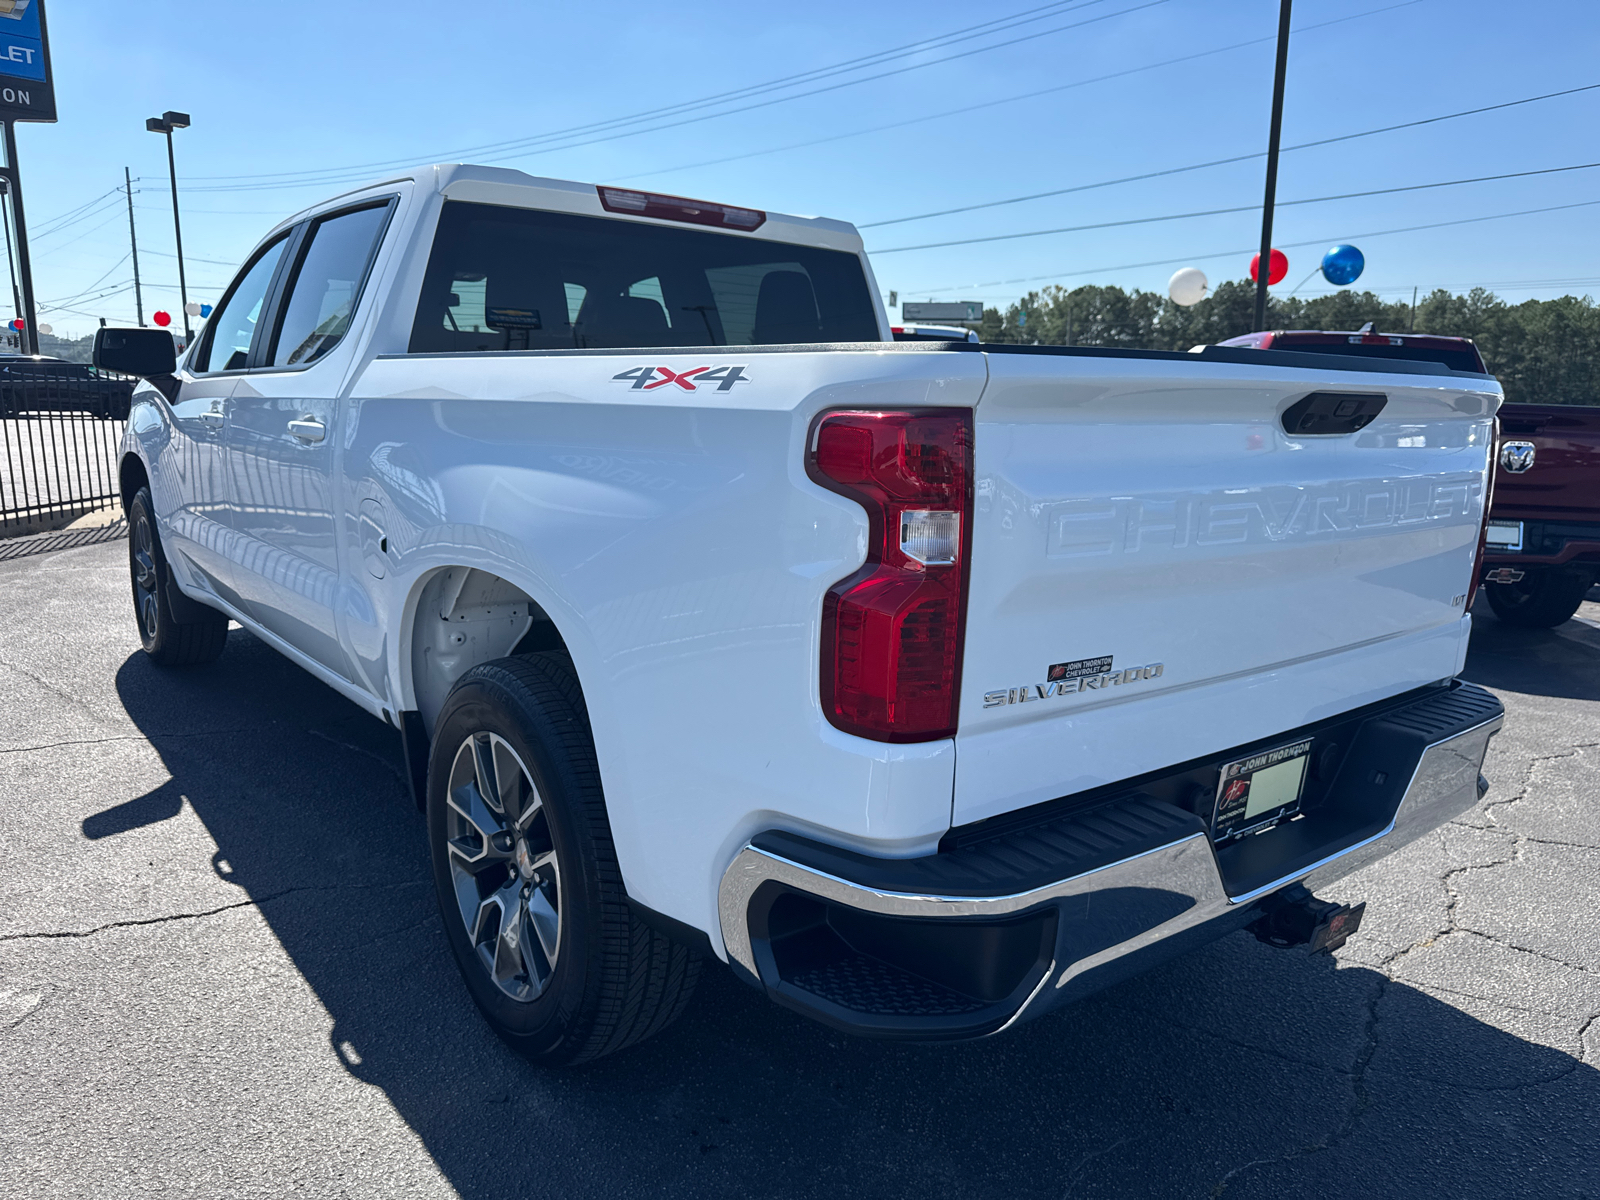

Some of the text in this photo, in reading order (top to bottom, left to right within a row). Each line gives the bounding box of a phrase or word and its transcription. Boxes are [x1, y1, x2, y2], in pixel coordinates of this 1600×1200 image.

[1046, 480, 1480, 560] CHEVROLET
[1065, 666, 1101, 678] CHEVROLET
[1066, 657, 1112, 671] JOHN THORNTON
[983, 662, 1164, 709] SILVERADO
[1243, 755, 1268, 771] JOHN
